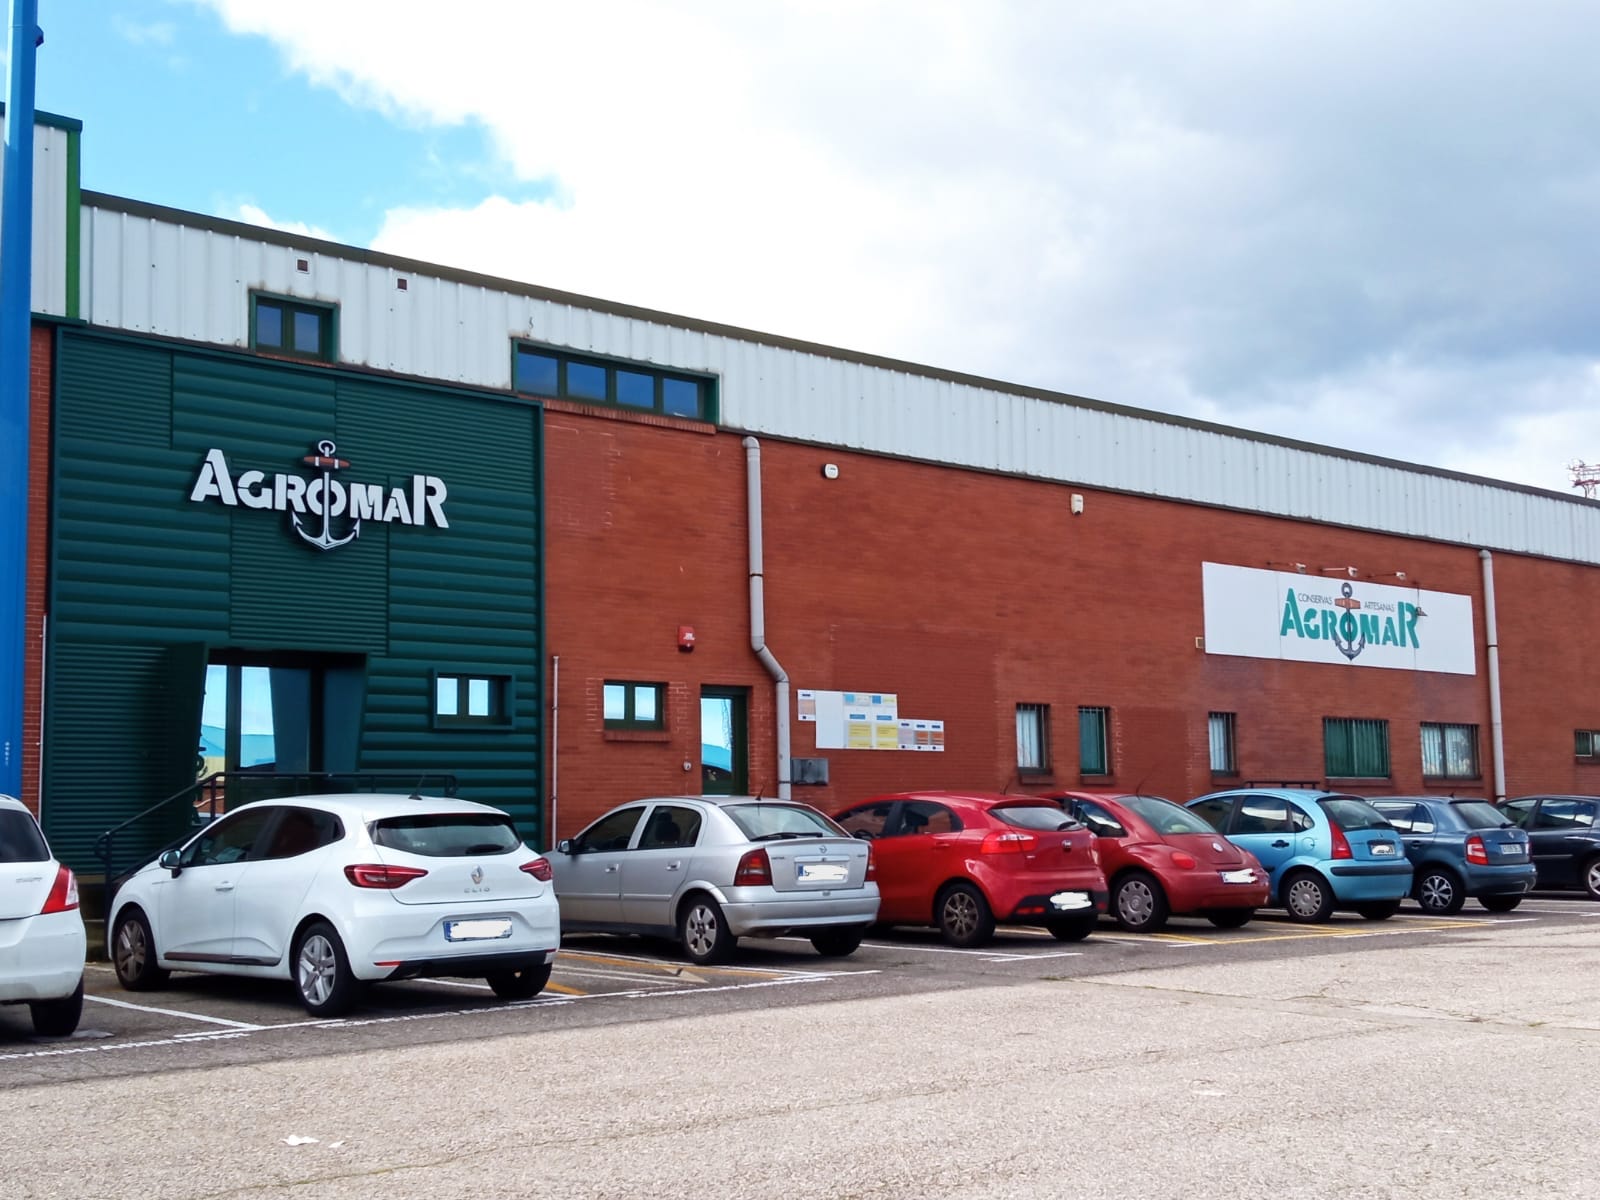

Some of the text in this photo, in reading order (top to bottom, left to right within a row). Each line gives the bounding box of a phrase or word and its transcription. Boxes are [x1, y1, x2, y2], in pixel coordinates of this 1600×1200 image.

[190, 448, 450, 529] AGROMAR
[1280, 588, 1420, 648] AGROMAR
[1298, 592, 1395, 613] CONSERVAS ARTESANAS
